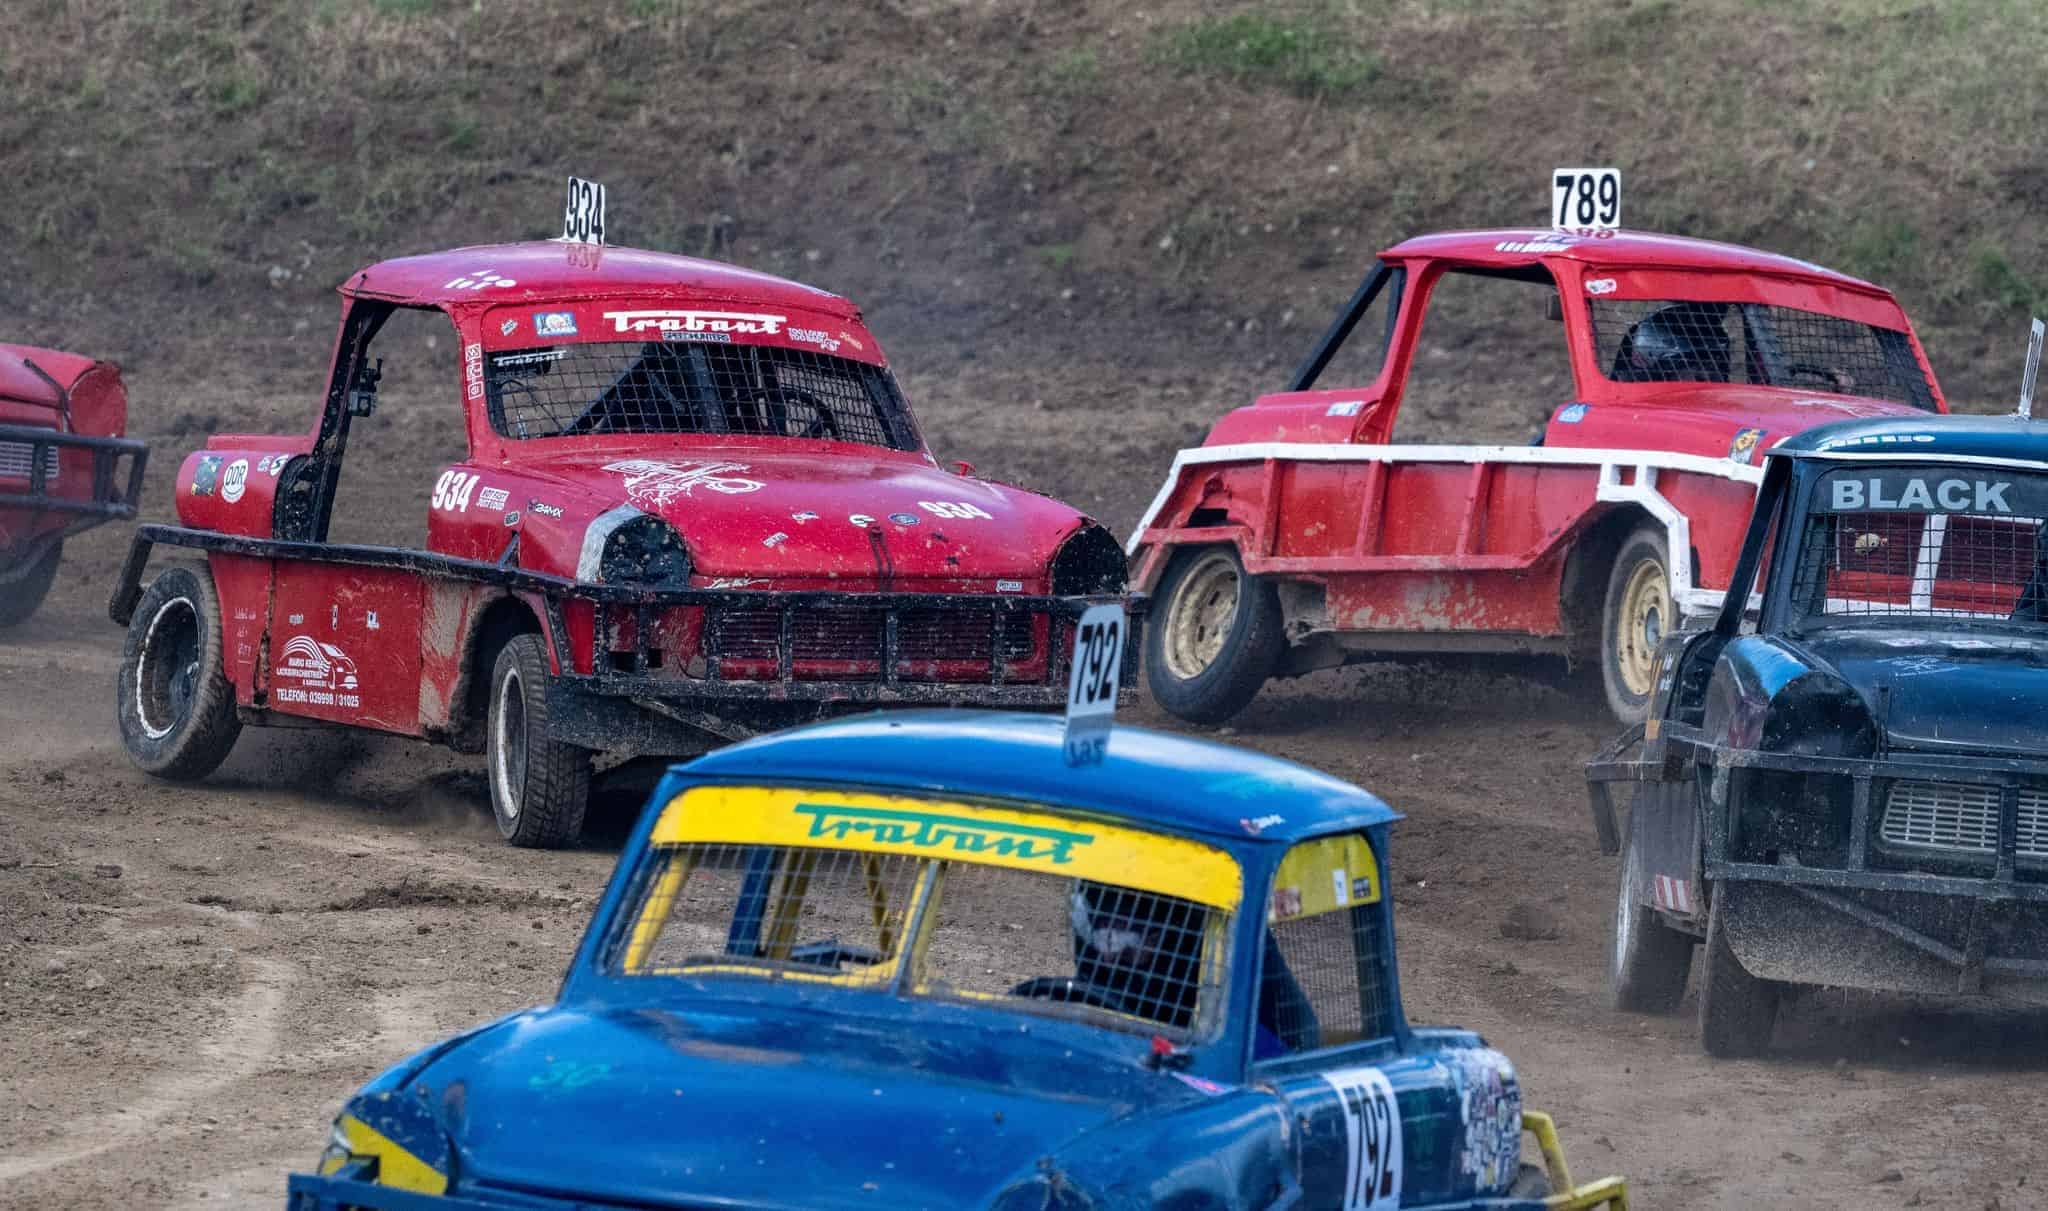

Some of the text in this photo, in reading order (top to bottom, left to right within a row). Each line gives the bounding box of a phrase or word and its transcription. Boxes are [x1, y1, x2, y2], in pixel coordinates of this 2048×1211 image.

[566, 178, 602, 245] 934
[1556, 174, 1617, 225] 789
[603, 310, 787, 334] Trabant
[493, 350, 567, 366] Trabant
[432, 470, 480, 512] 934
[918, 501, 993, 520] 934
[1831, 479, 2012, 513] BLACK
[1063, 621, 1119, 704] 792
[277, 688, 308, 703] TELEFON:
[339, 694, 360, 708] 31025
[793, 803, 1095, 864] Trabant
[1342, 1083, 1393, 1208] 792
